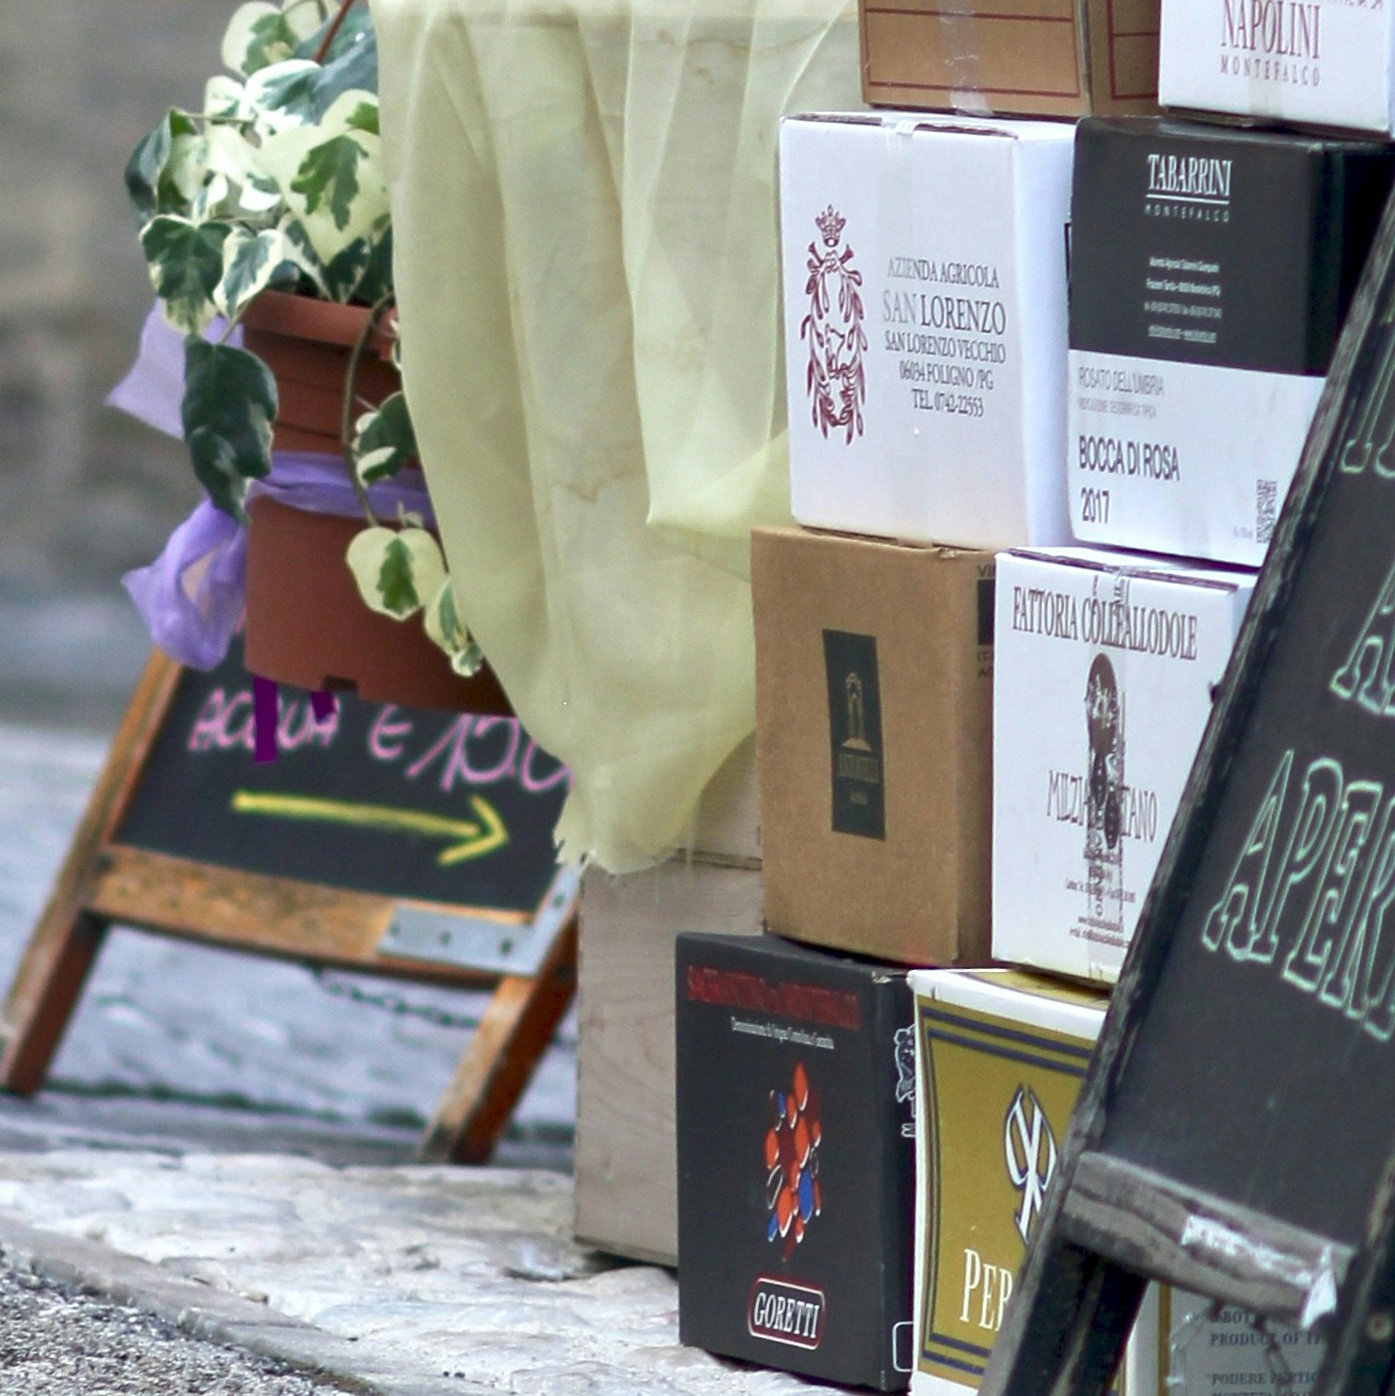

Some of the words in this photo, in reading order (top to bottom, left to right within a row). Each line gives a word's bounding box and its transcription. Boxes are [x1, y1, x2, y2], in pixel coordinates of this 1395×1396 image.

[1220, 54, 1320, 86] MONTEFALCO
[1147, 153, 1232, 196] TABARRINI
[1144, 204, 1230, 223] MONTEFALCO
[887, 257, 939, 282] AZIENDA
[939, 262, 1000, 289] AGRICOLA
[883, 290, 917, 324] SAN
[921, 294, 1006, 335] LORENZO
[885, 330, 905, 351] SAN
[907, 333, 955, 358] LORENZO
[957, 339, 1006, 363] VECCHIO
[927, 362, 975, 388] FOLIGNO
[1079, 435, 1125, 475] BOCCA
[1127, 441, 1141, 476] DI
[1142, 443, 1181, 482] ROSA
[1081, 487, 1111, 524] 2017
[1012, 586, 1079, 640] FATTORIA
[754, 1292, 820, 1339] GORETTI
